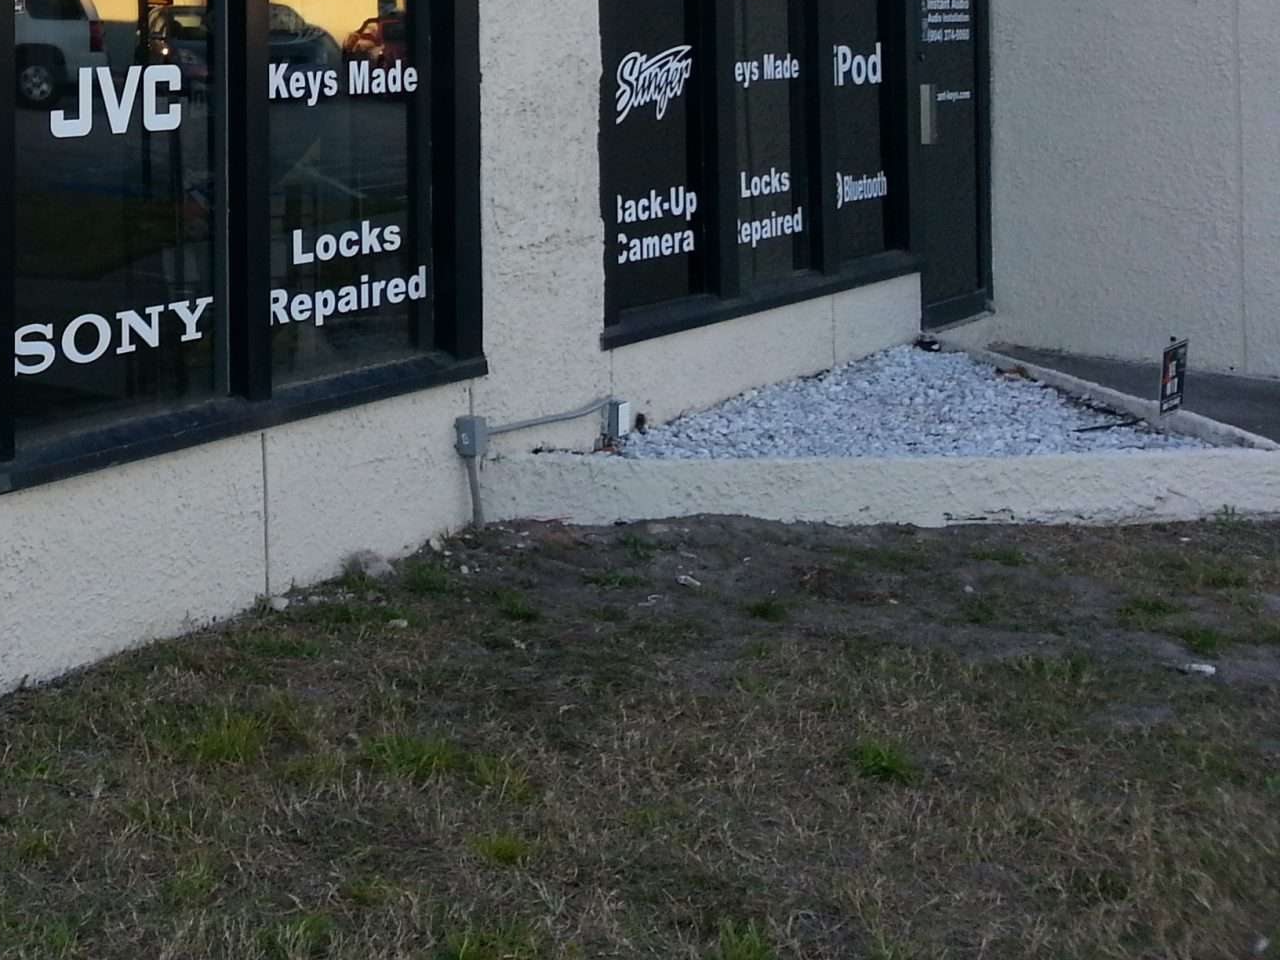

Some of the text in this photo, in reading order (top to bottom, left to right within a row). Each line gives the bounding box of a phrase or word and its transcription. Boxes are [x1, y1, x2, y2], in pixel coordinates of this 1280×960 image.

[268, 59, 419, 107] Keys Made
[734, 52, 800, 88] eys Made
[833, 41, 882, 87] iPod
[50, 64, 183, 139] JVC
[740, 167, 791, 198] Locks
[843, 170, 888, 202] Bluetooth
[292, 220, 402, 265] Locks
[270, 265, 427, 326] Repaired
[14, 296, 214, 377] SONY
